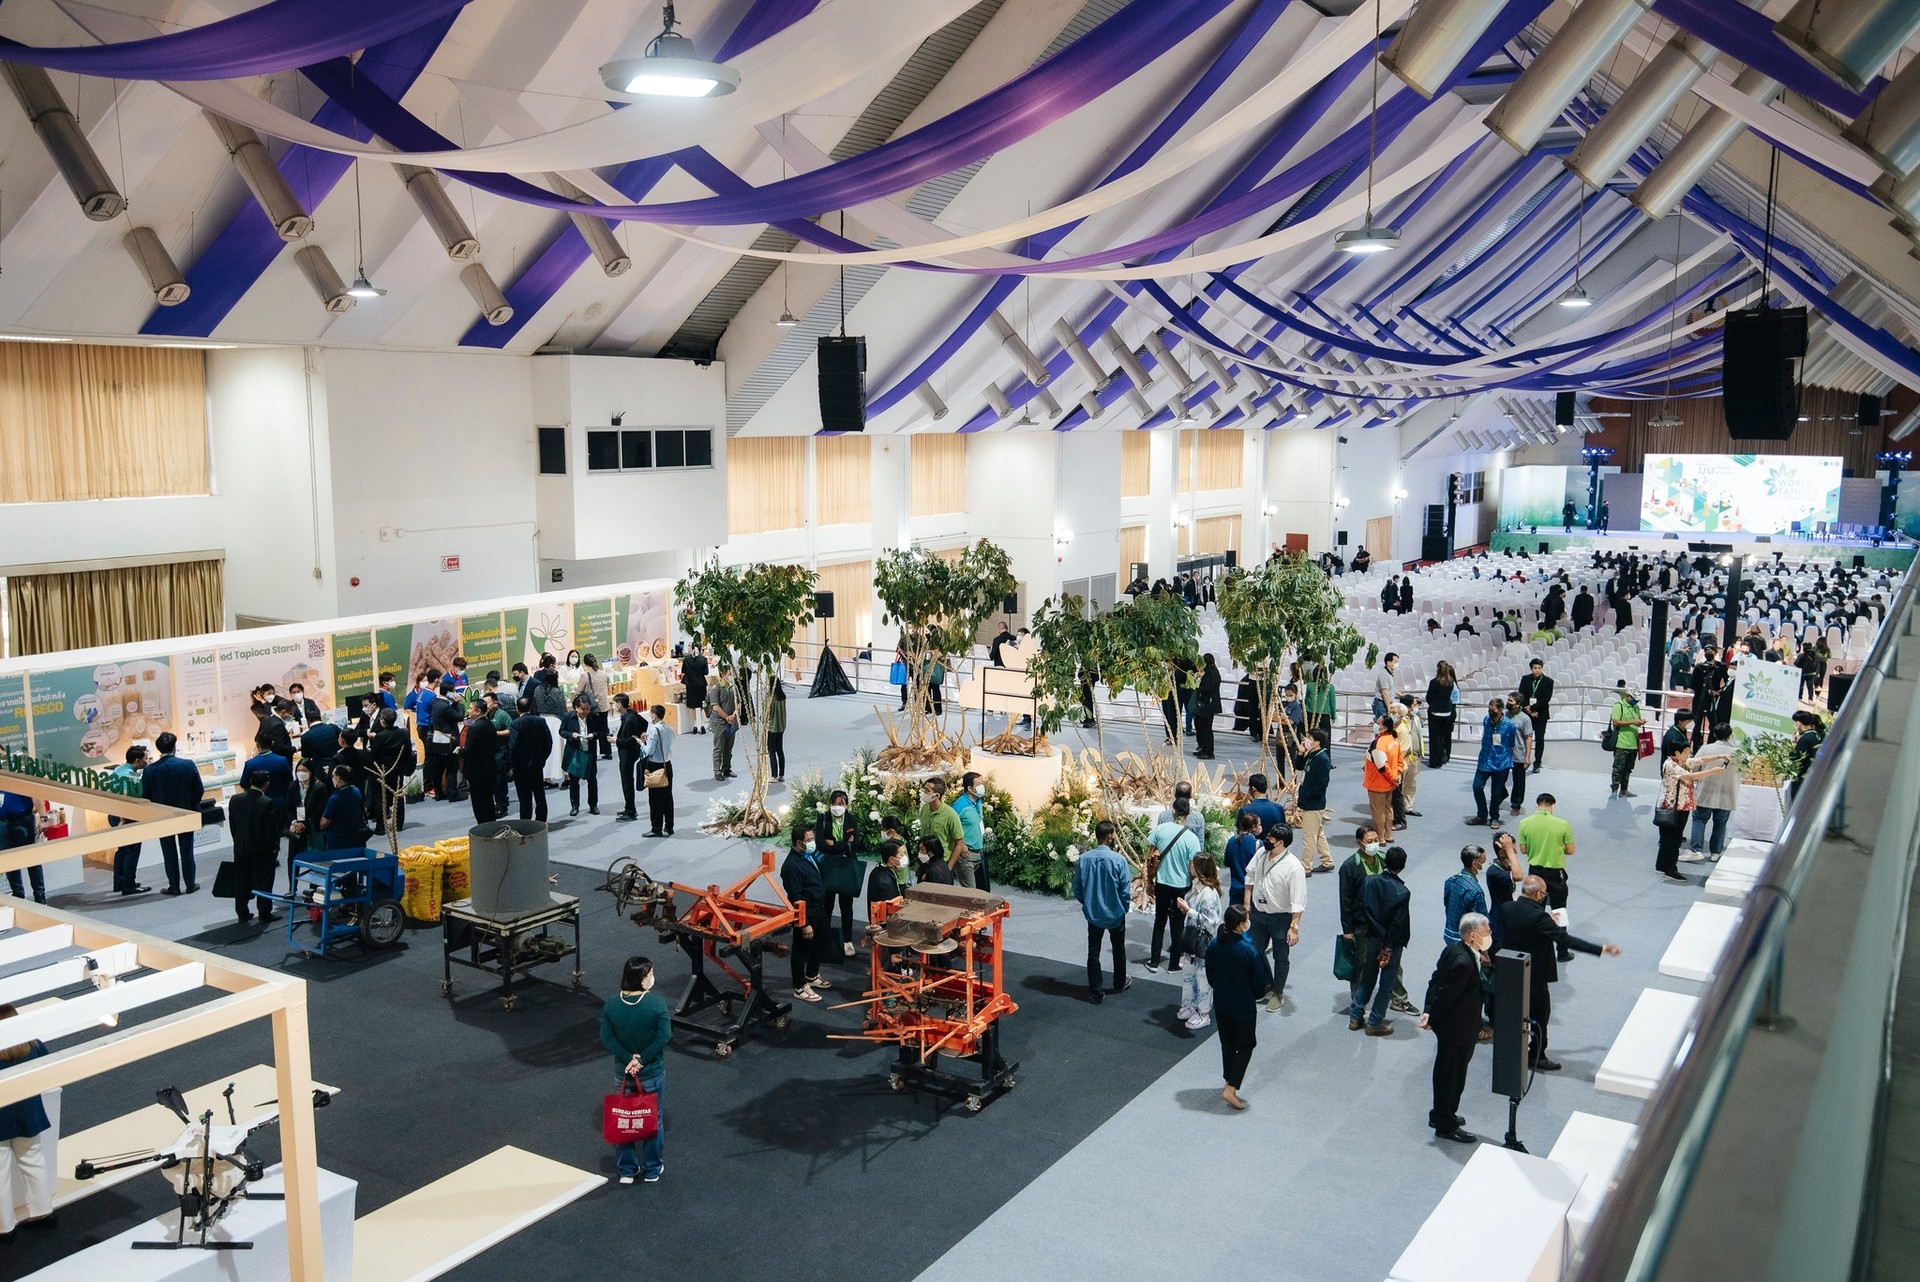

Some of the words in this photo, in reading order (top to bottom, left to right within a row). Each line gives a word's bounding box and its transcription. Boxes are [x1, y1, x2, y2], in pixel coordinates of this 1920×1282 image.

[1778, 479, 1813, 487] WORLD
[1778, 488, 1819, 496] TAPIOCA
[192, 652, 233, 666] Modiied
[234, 648, 271, 660] Tapioca
[272, 643, 301, 654] Starch
[480, 651, 502, 661] trusted
[1756, 686, 1783, 697] WORLD
[1756, 693, 1789, 705] TAPIOCA
[14, 701, 64, 718] RSECO
[612, 1107, 631, 1115] BUREAU
